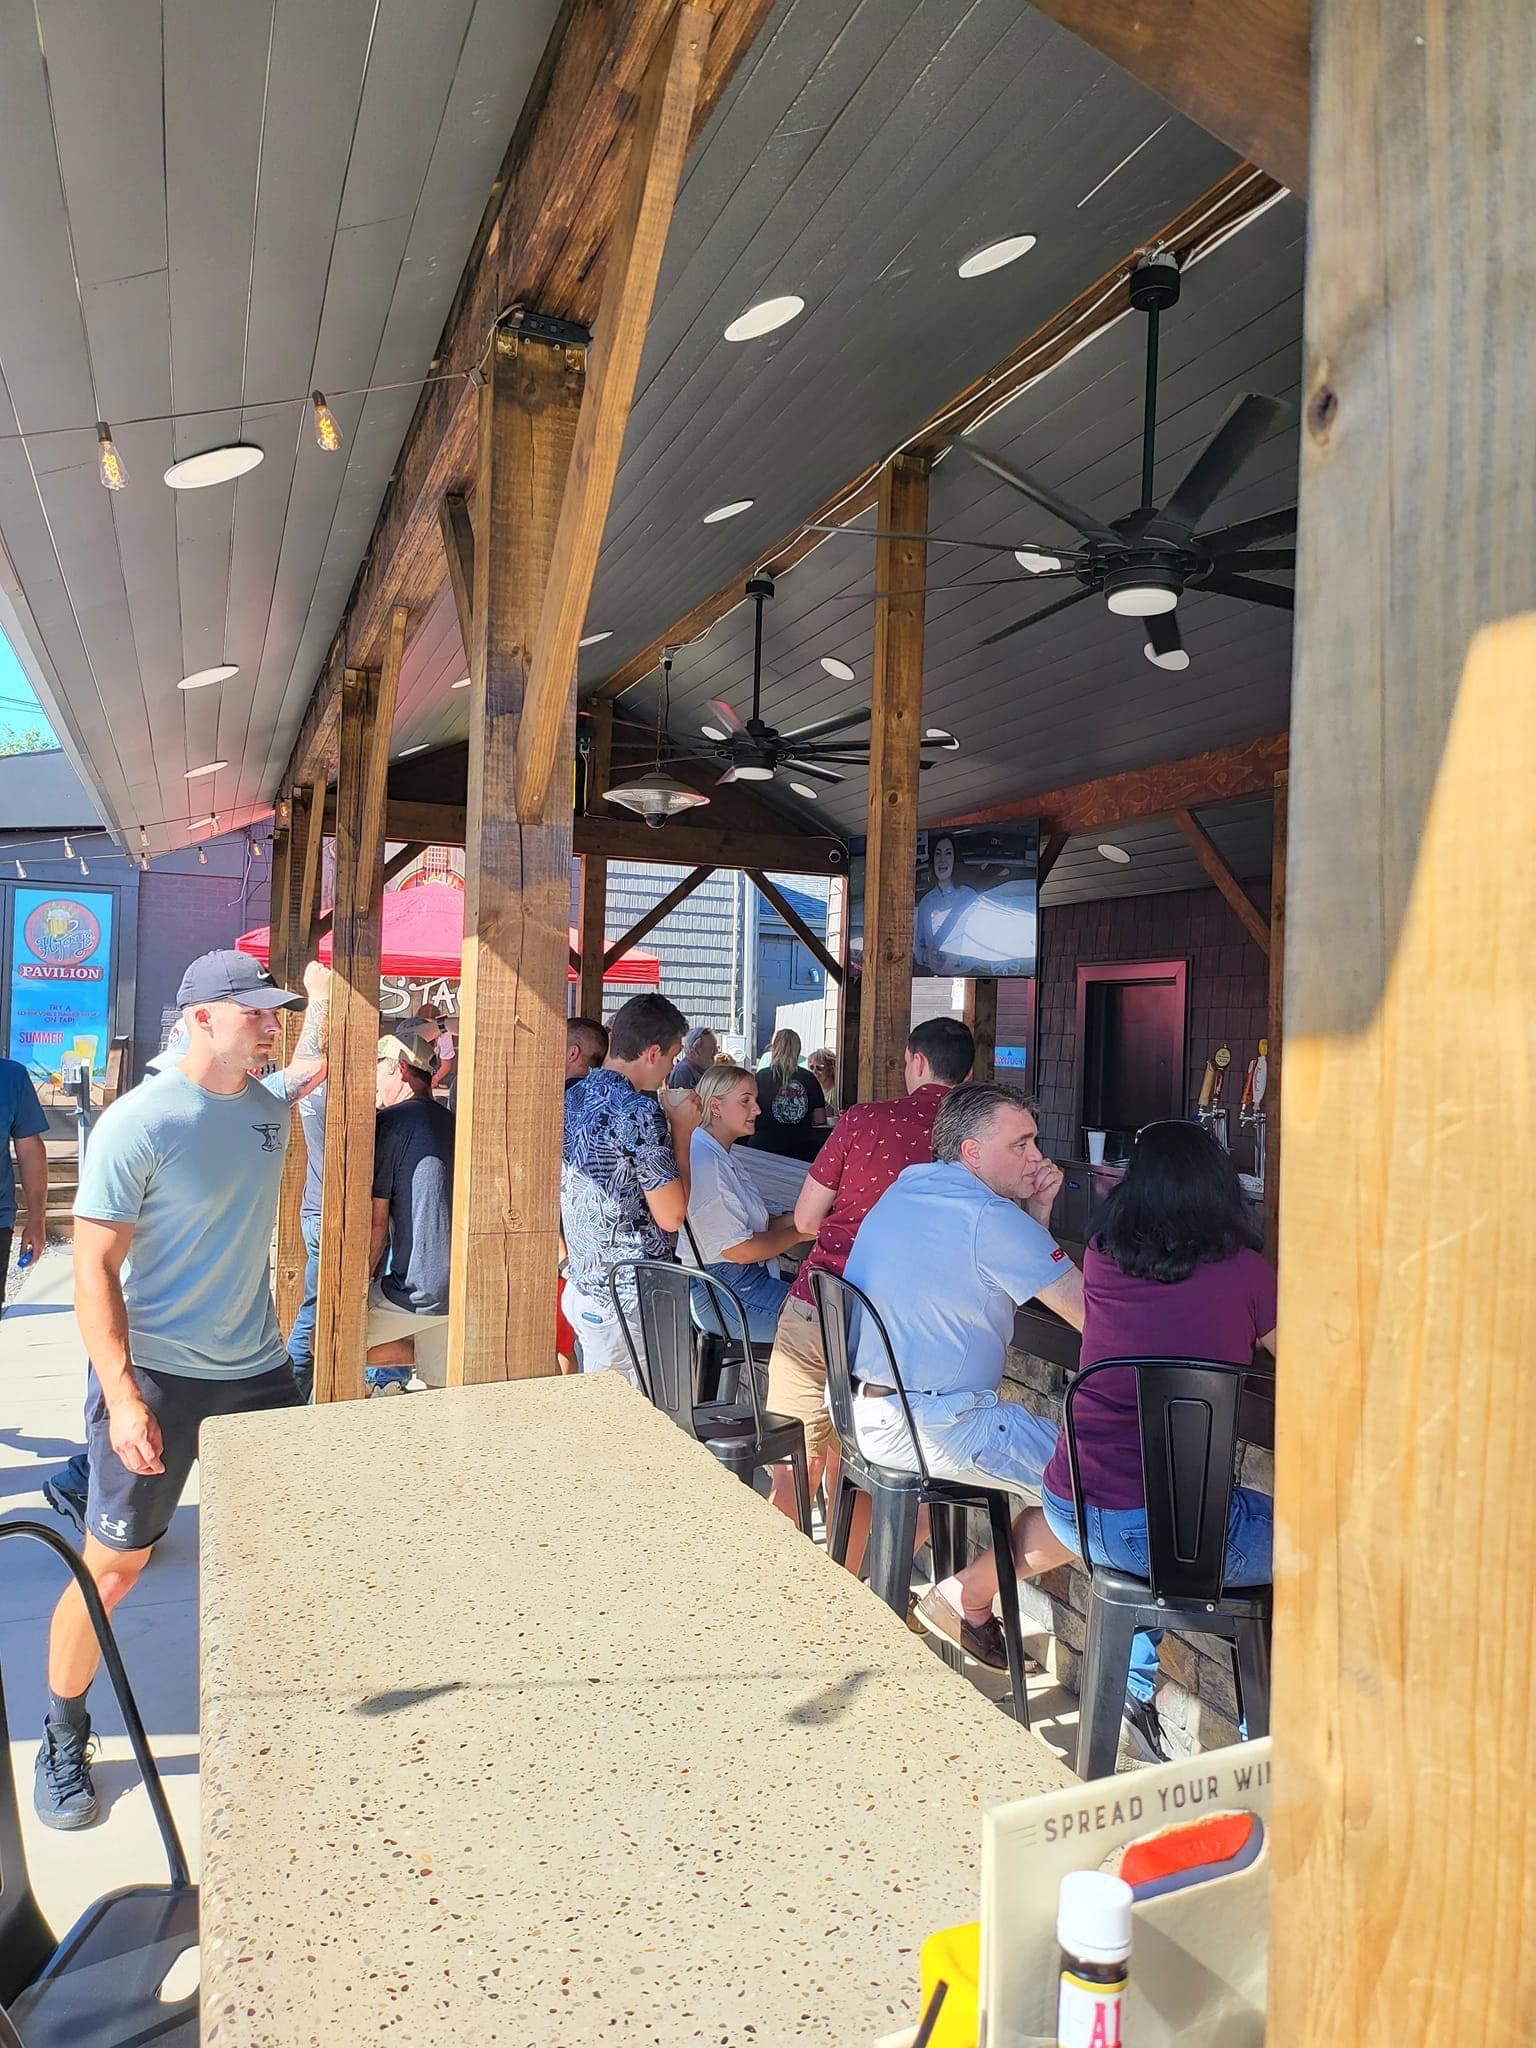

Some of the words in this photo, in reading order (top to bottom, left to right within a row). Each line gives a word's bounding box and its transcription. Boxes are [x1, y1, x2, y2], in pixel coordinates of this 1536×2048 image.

[22, 966, 99, 979] PAVILION
[380, 976, 461, 1014] STA
[19, 1031, 64, 1044] SUMMER
[1044, 1796, 1143, 1843] SPREAD
[1157, 1775, 1219, 1812] YOUR
